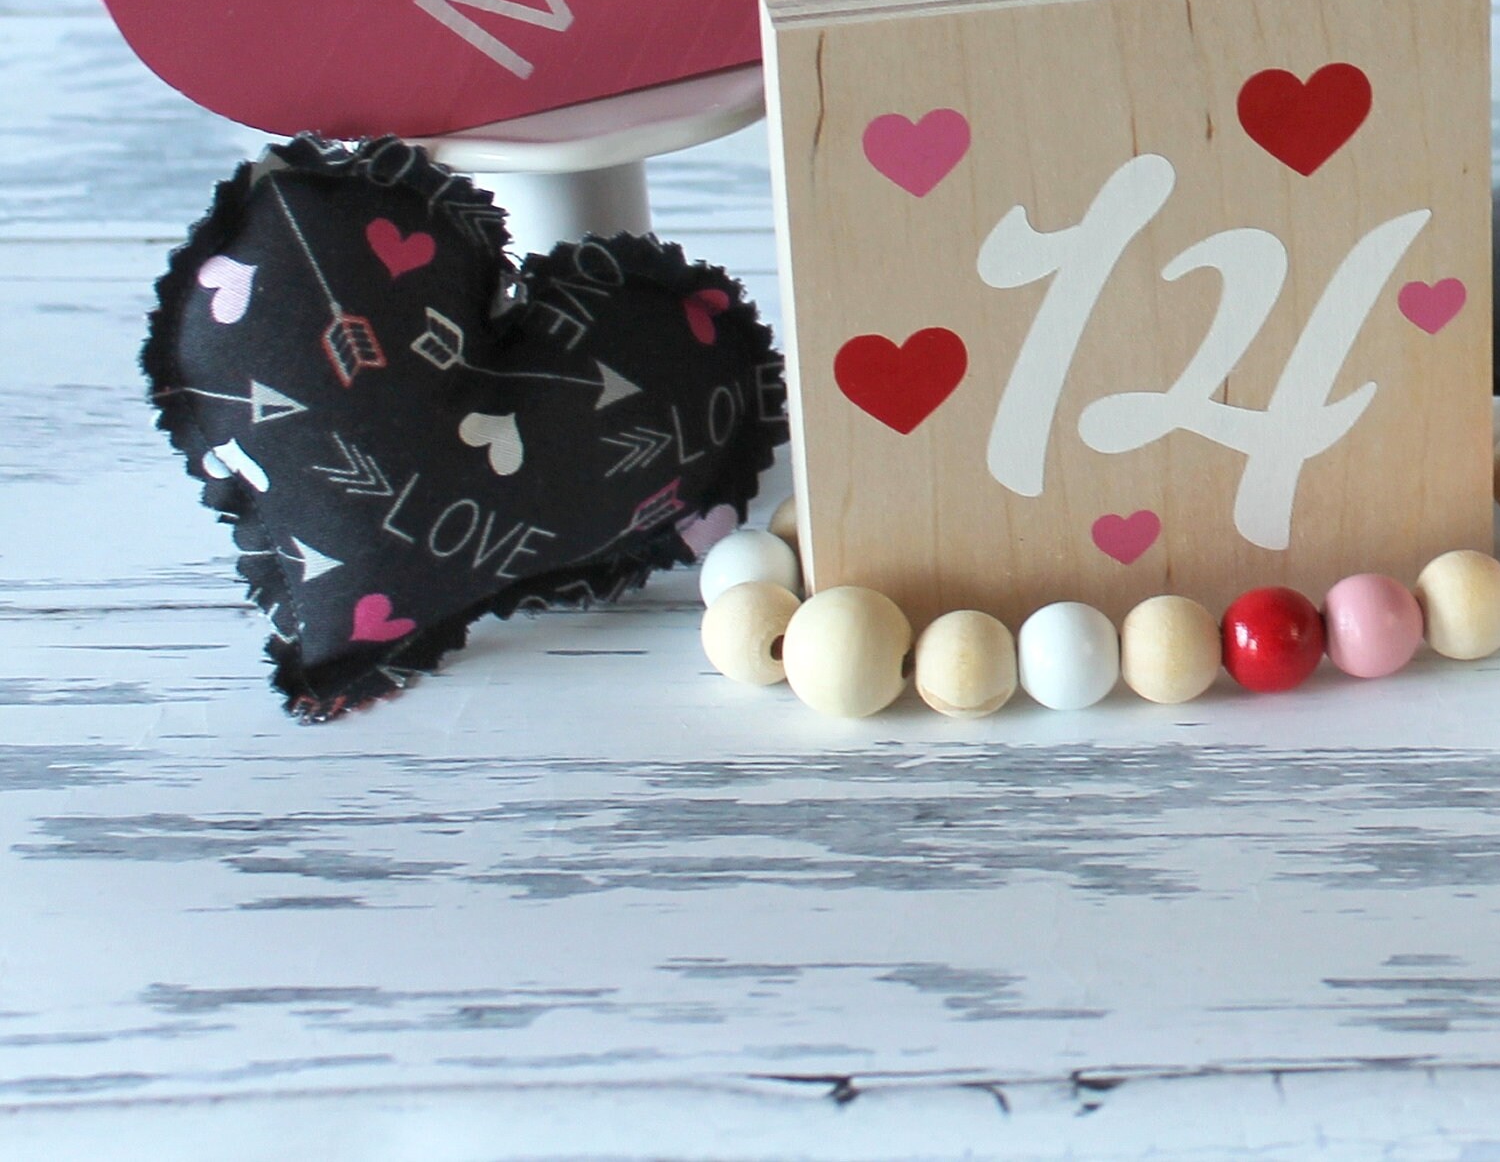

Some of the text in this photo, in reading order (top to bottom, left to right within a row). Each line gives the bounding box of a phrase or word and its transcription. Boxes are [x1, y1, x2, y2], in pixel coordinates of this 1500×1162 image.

[527, 234, 660, 350] OVE
[976, 153, 1433, 551] 14
[382, 472, 556, 579] LOVE
